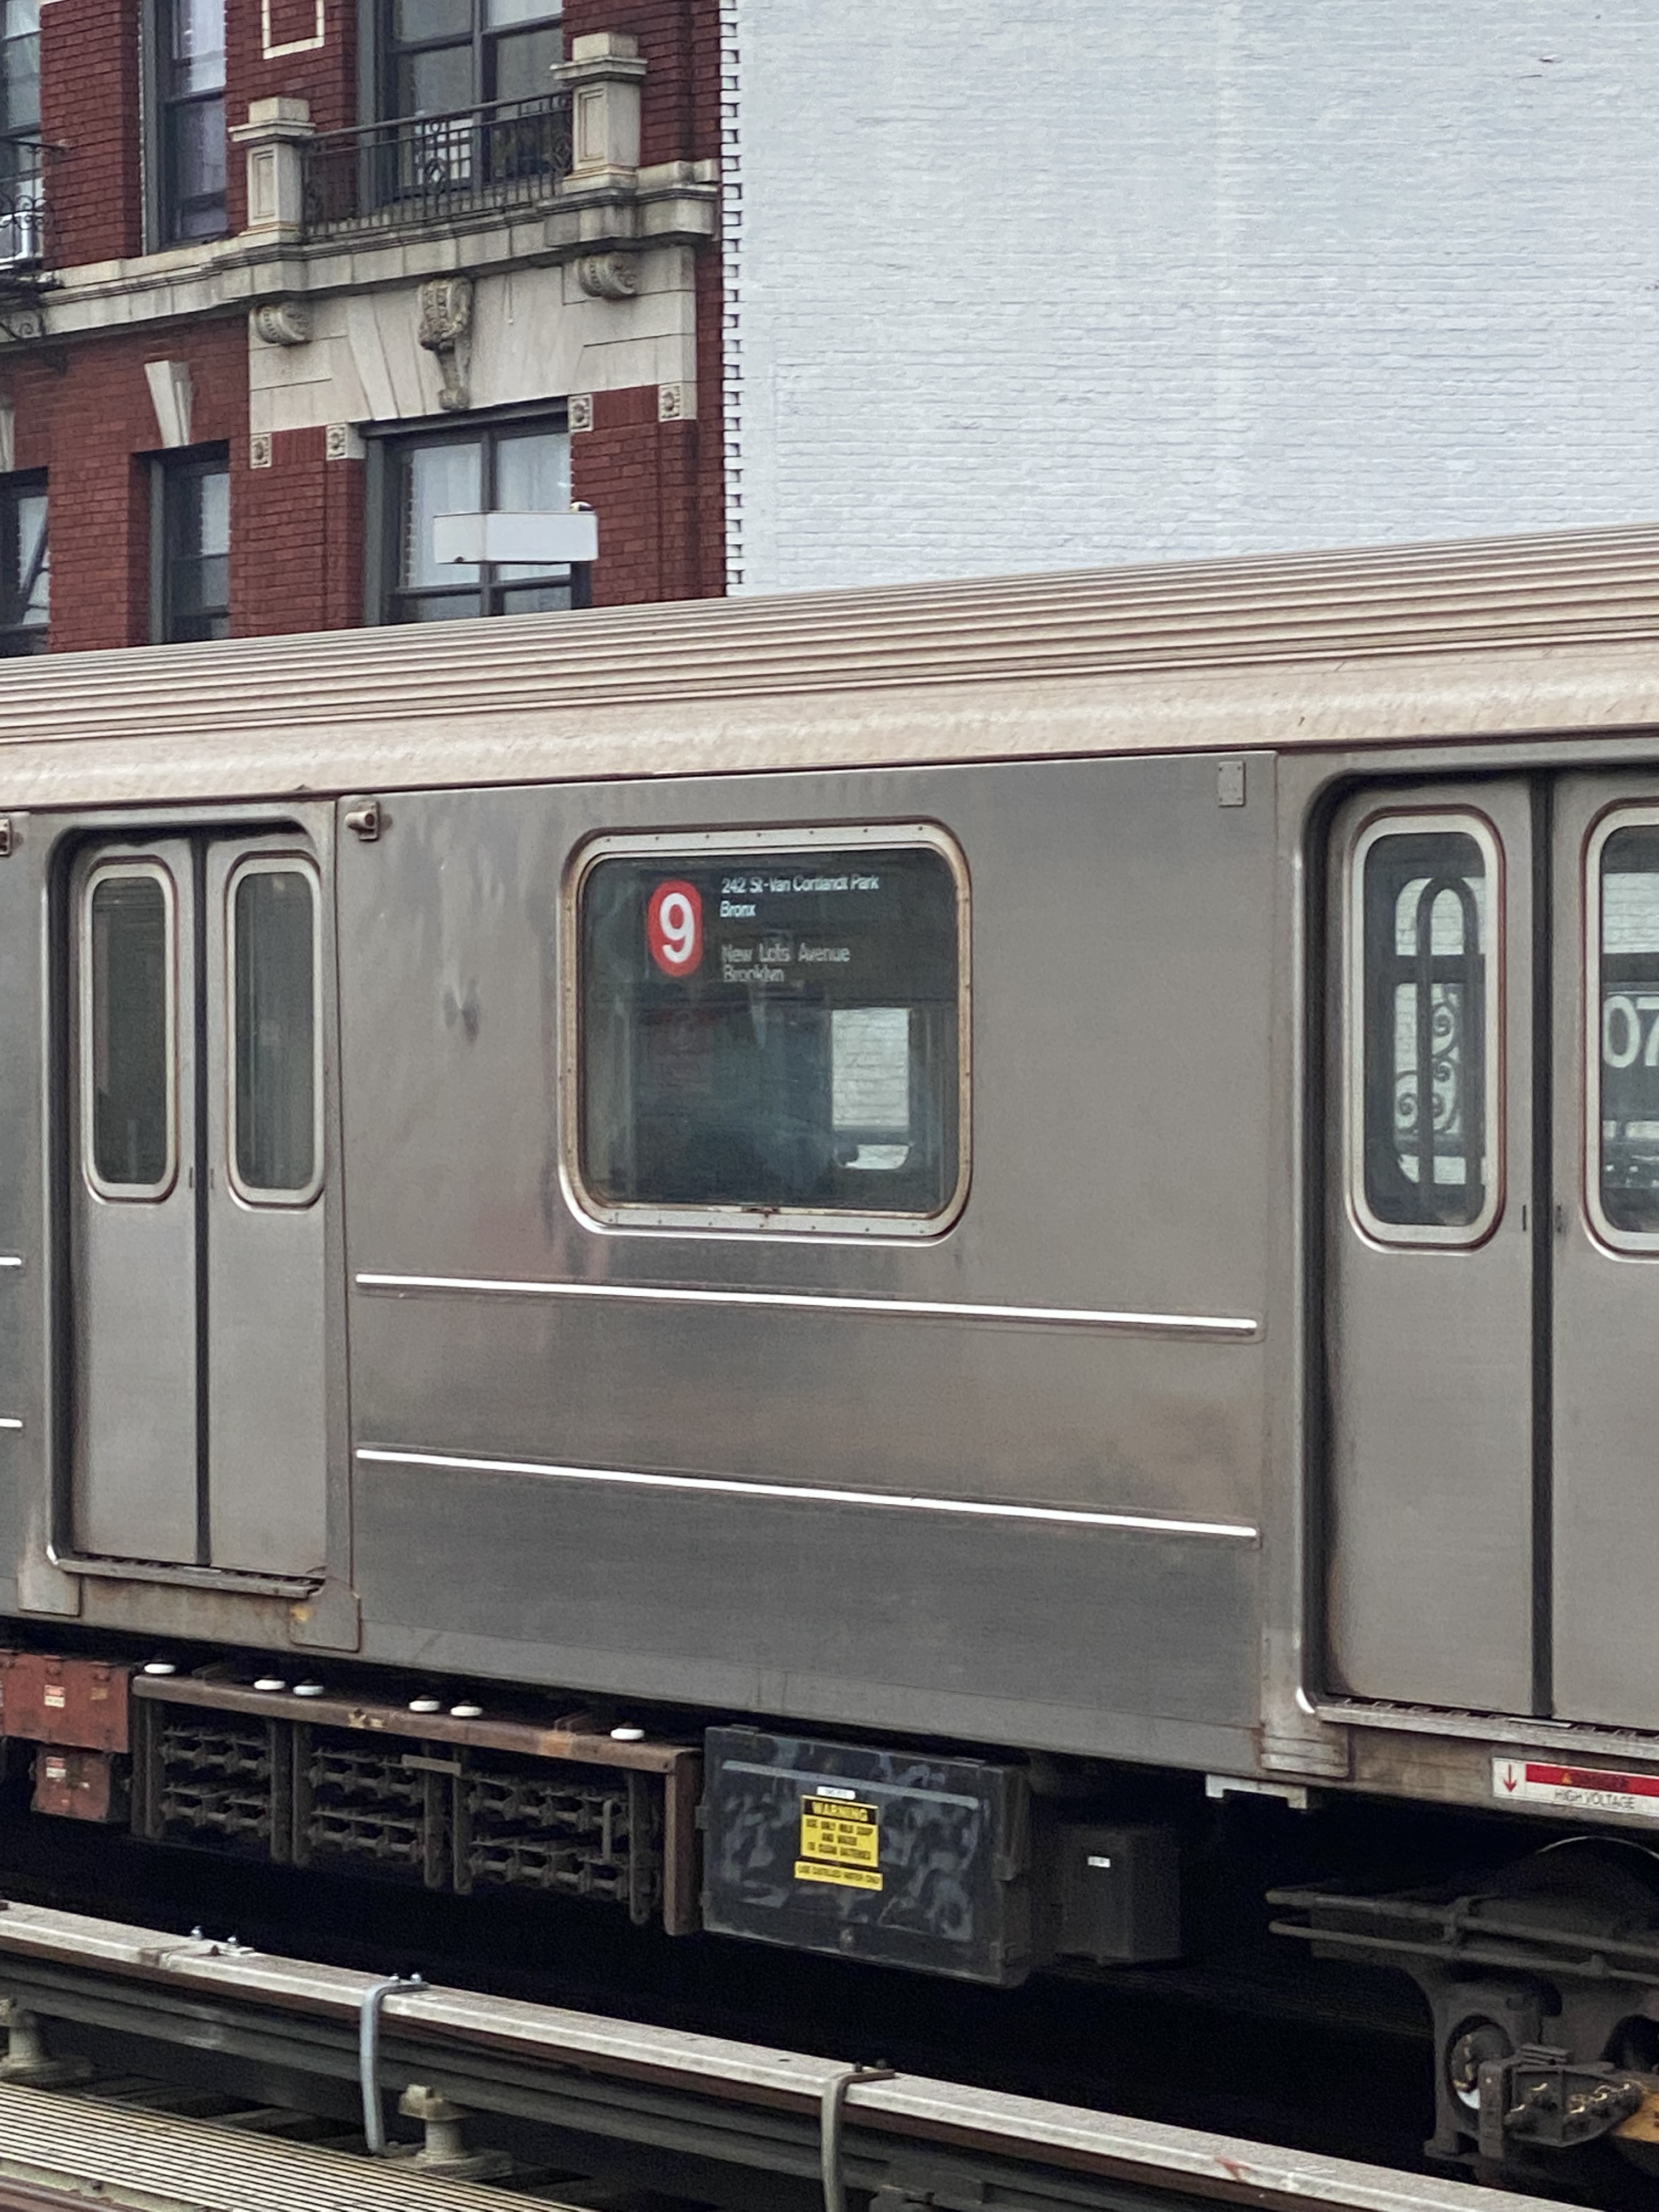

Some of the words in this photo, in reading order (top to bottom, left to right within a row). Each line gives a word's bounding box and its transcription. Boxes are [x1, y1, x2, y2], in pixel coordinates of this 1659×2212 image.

[721, 877, 747, 894] 242
[850, 874, 879, 890] Park
[720, 900, 757, 917] Bronx
[660, 893, 695, 963] 9
[722, 944, 752, 962] New
[759, 943, 790, 961] Lots
[798, 942, 850, 962] Avenue
[812, 1801, 868, 1821] WARNING
